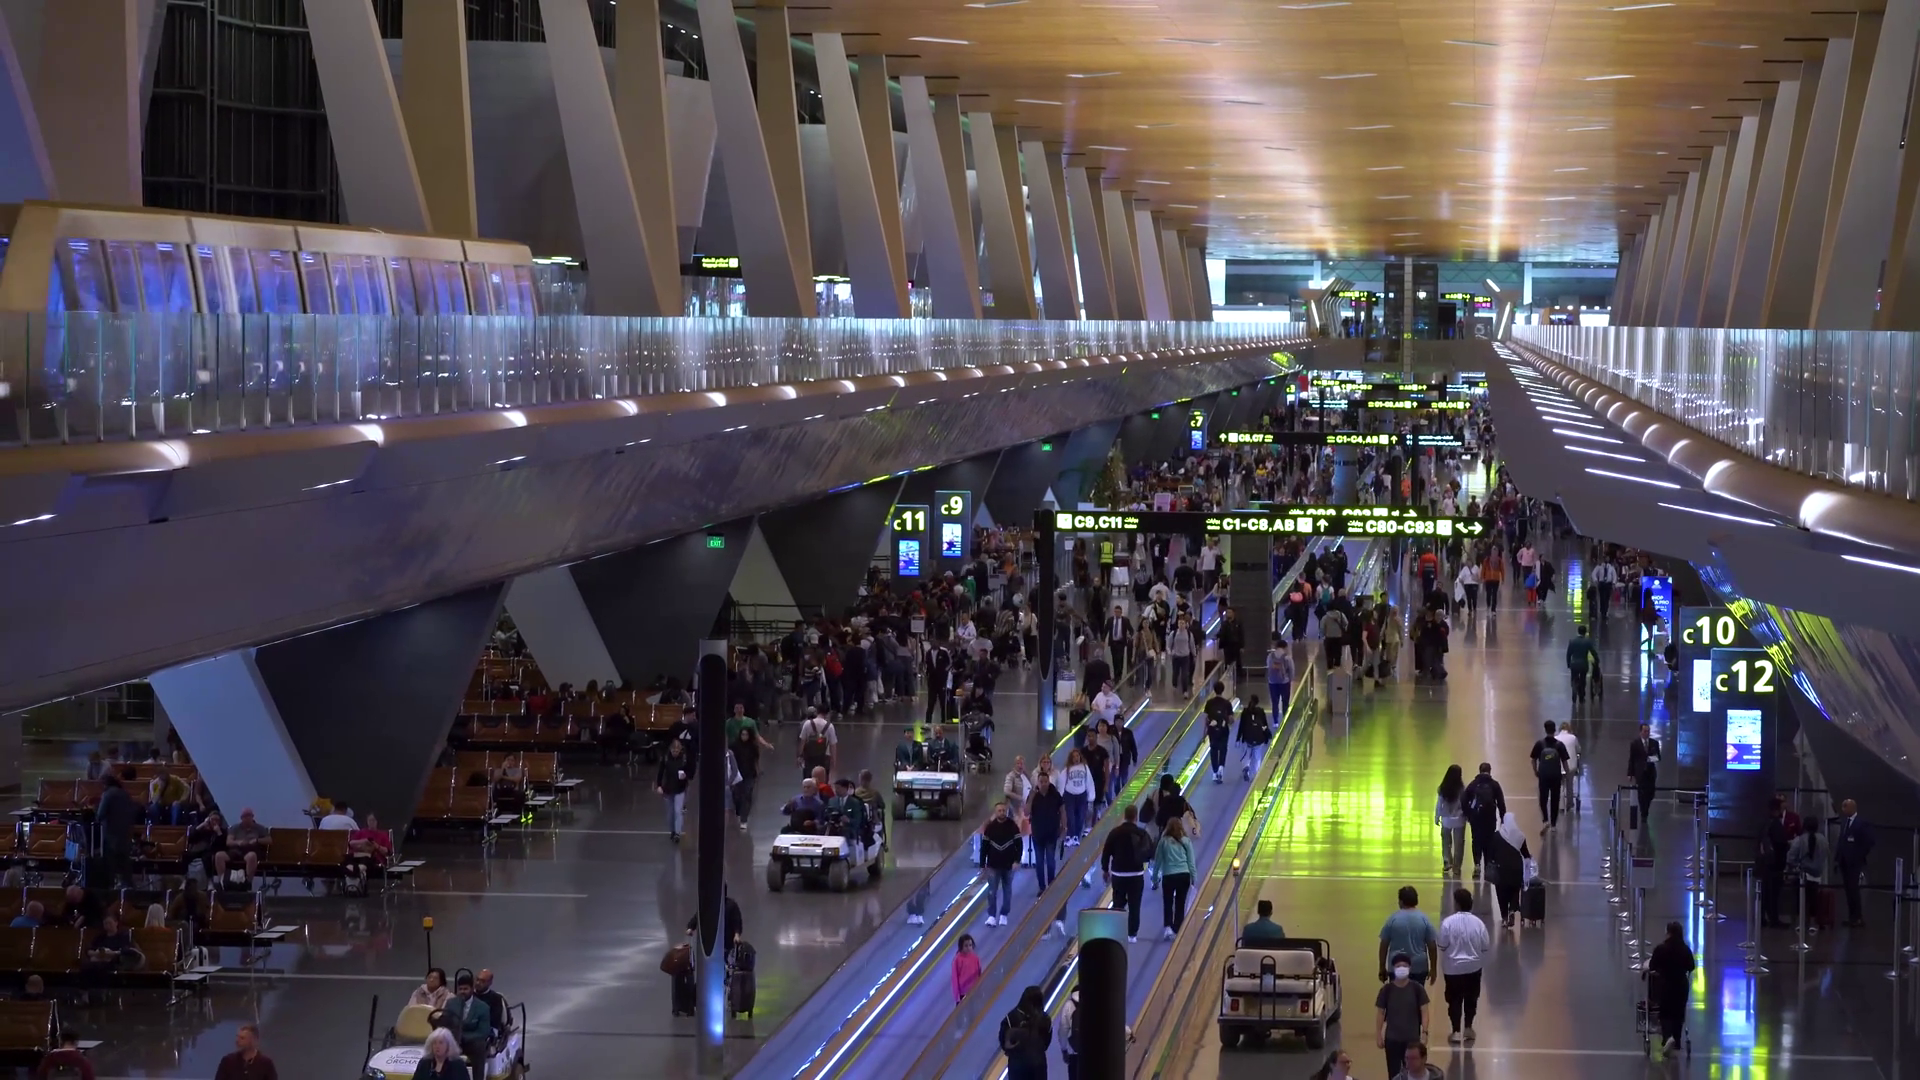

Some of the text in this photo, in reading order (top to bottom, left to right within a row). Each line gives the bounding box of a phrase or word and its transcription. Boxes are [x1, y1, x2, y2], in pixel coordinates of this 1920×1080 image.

[1190, 415, 1204, 427] c7
[941, 495, 963, 515] c9
[893, 510, 925, 531] c11
[1222, 517, 1295, 532] C1-C8,AB
[1365, 519, 1434, 534] C80-C93
[1682, 615, 1736, 646] c10
[1715, 659, 1775, 693] c12
